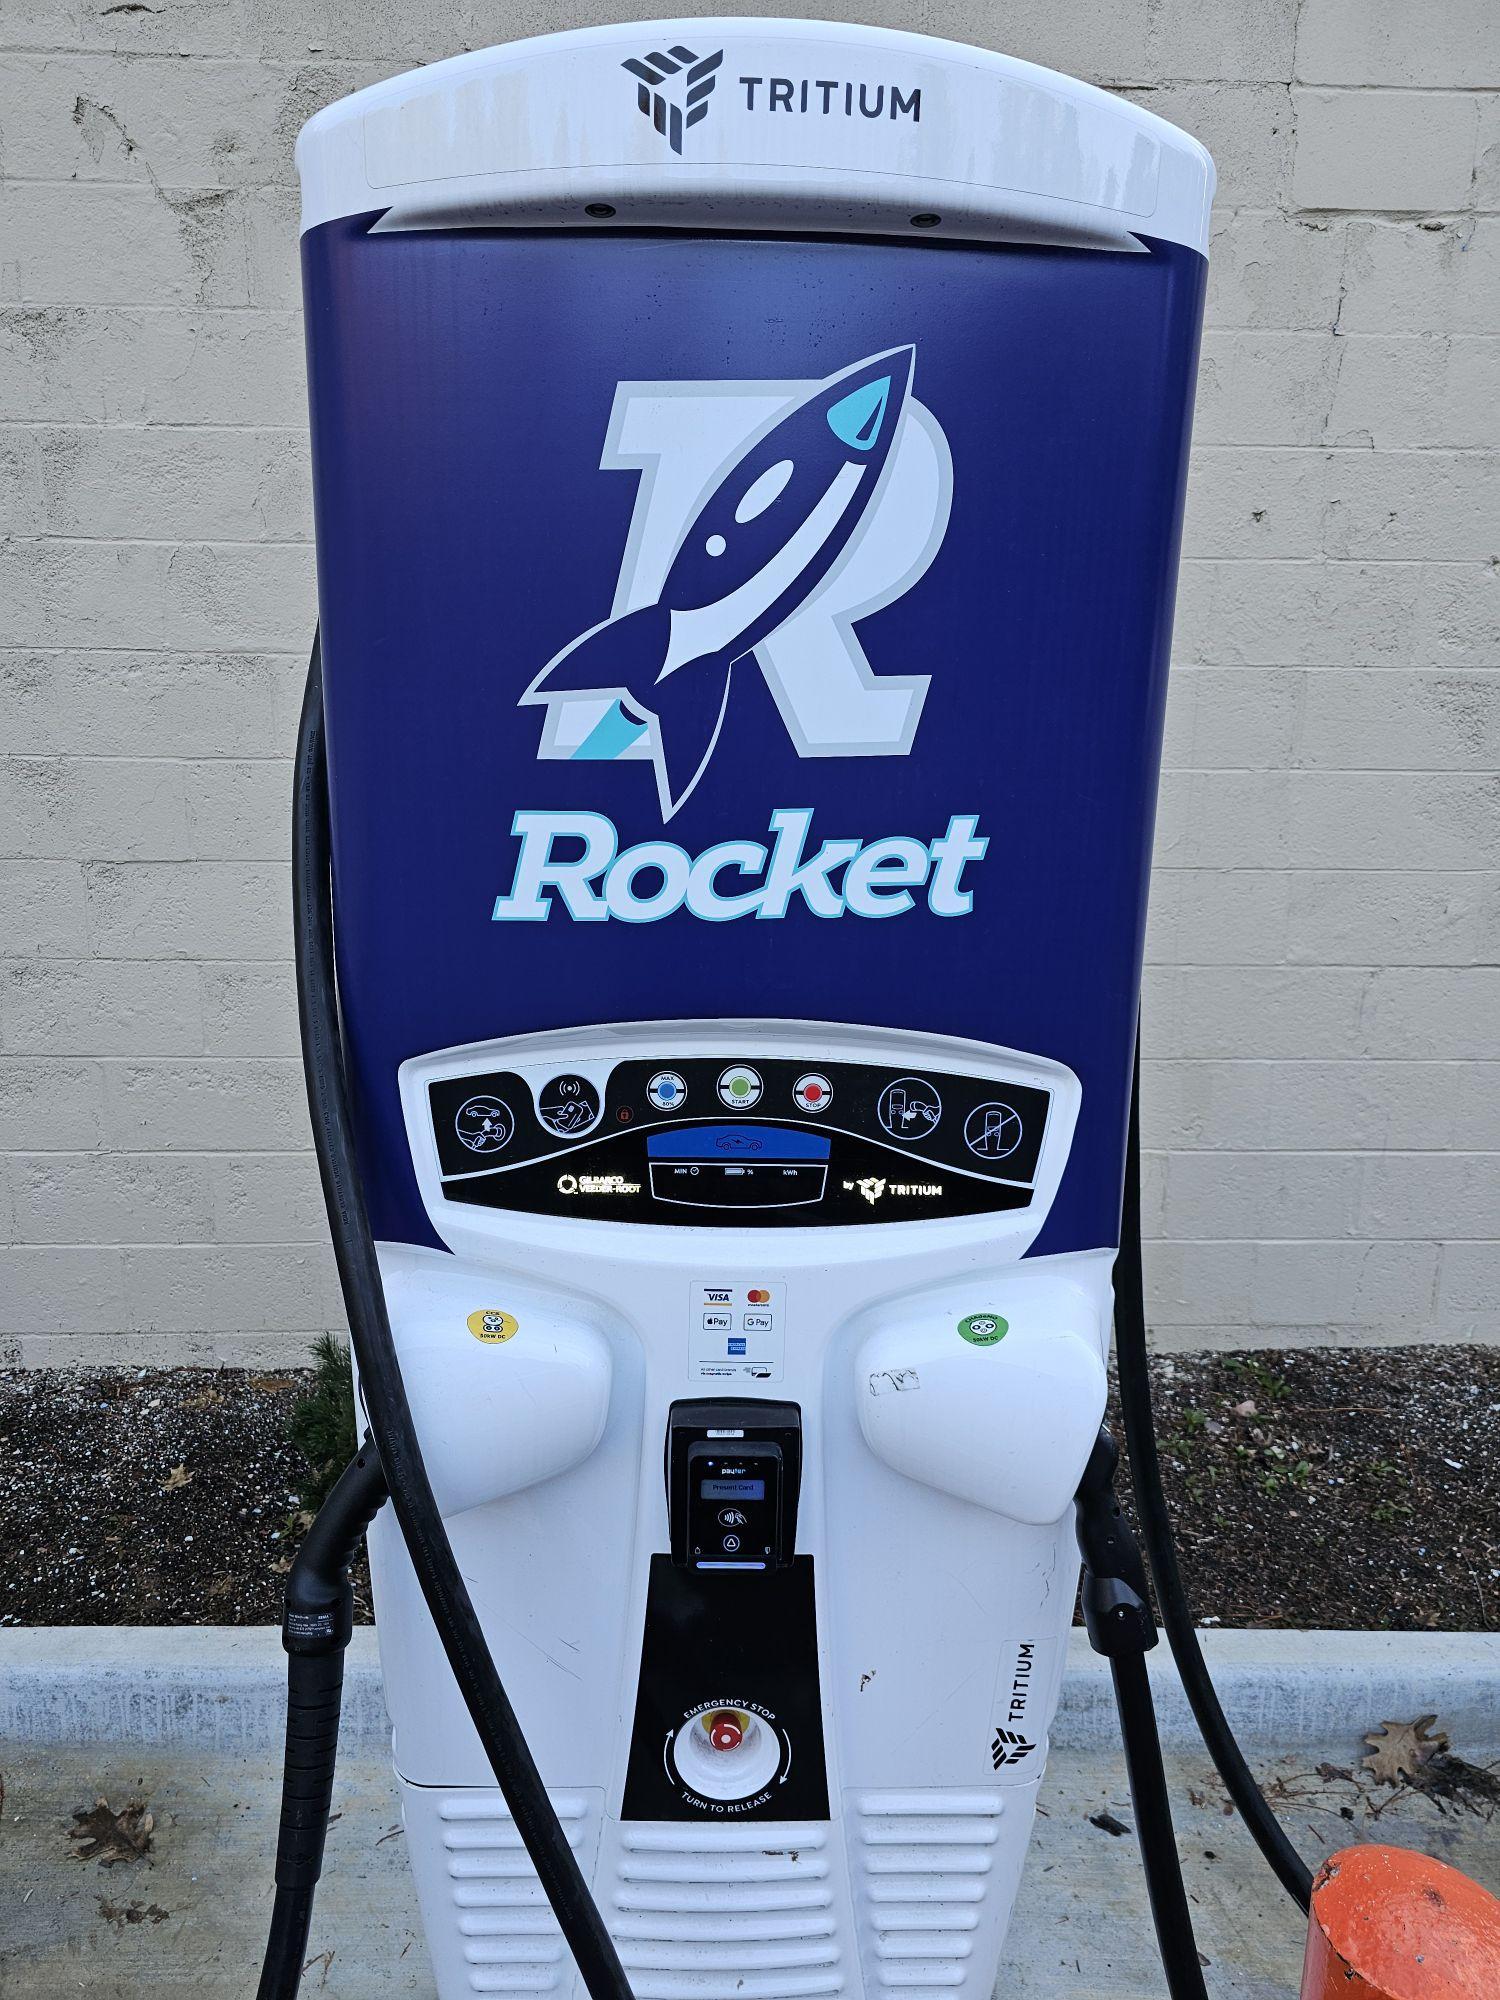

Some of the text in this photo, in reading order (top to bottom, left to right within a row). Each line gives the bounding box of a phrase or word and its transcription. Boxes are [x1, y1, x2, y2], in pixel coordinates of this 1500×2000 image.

[738, 76, 922, 123] TRITIUM
[491, 808, 990, 924] Rocket
[888, 1184, 943, 1196] TRITIUM
[708, 1293, 730, 1302] VISA
[713, 1317, 728, 1327] Pay
[755, 1318, 769, 1328] Pay
[1007, 1643, 1035, 1722] TRITIUM
[683, 1699, 776, 1720] EMERGENCY STOP
[681, 1791, 773, 1813] TURN TO RELEASE
